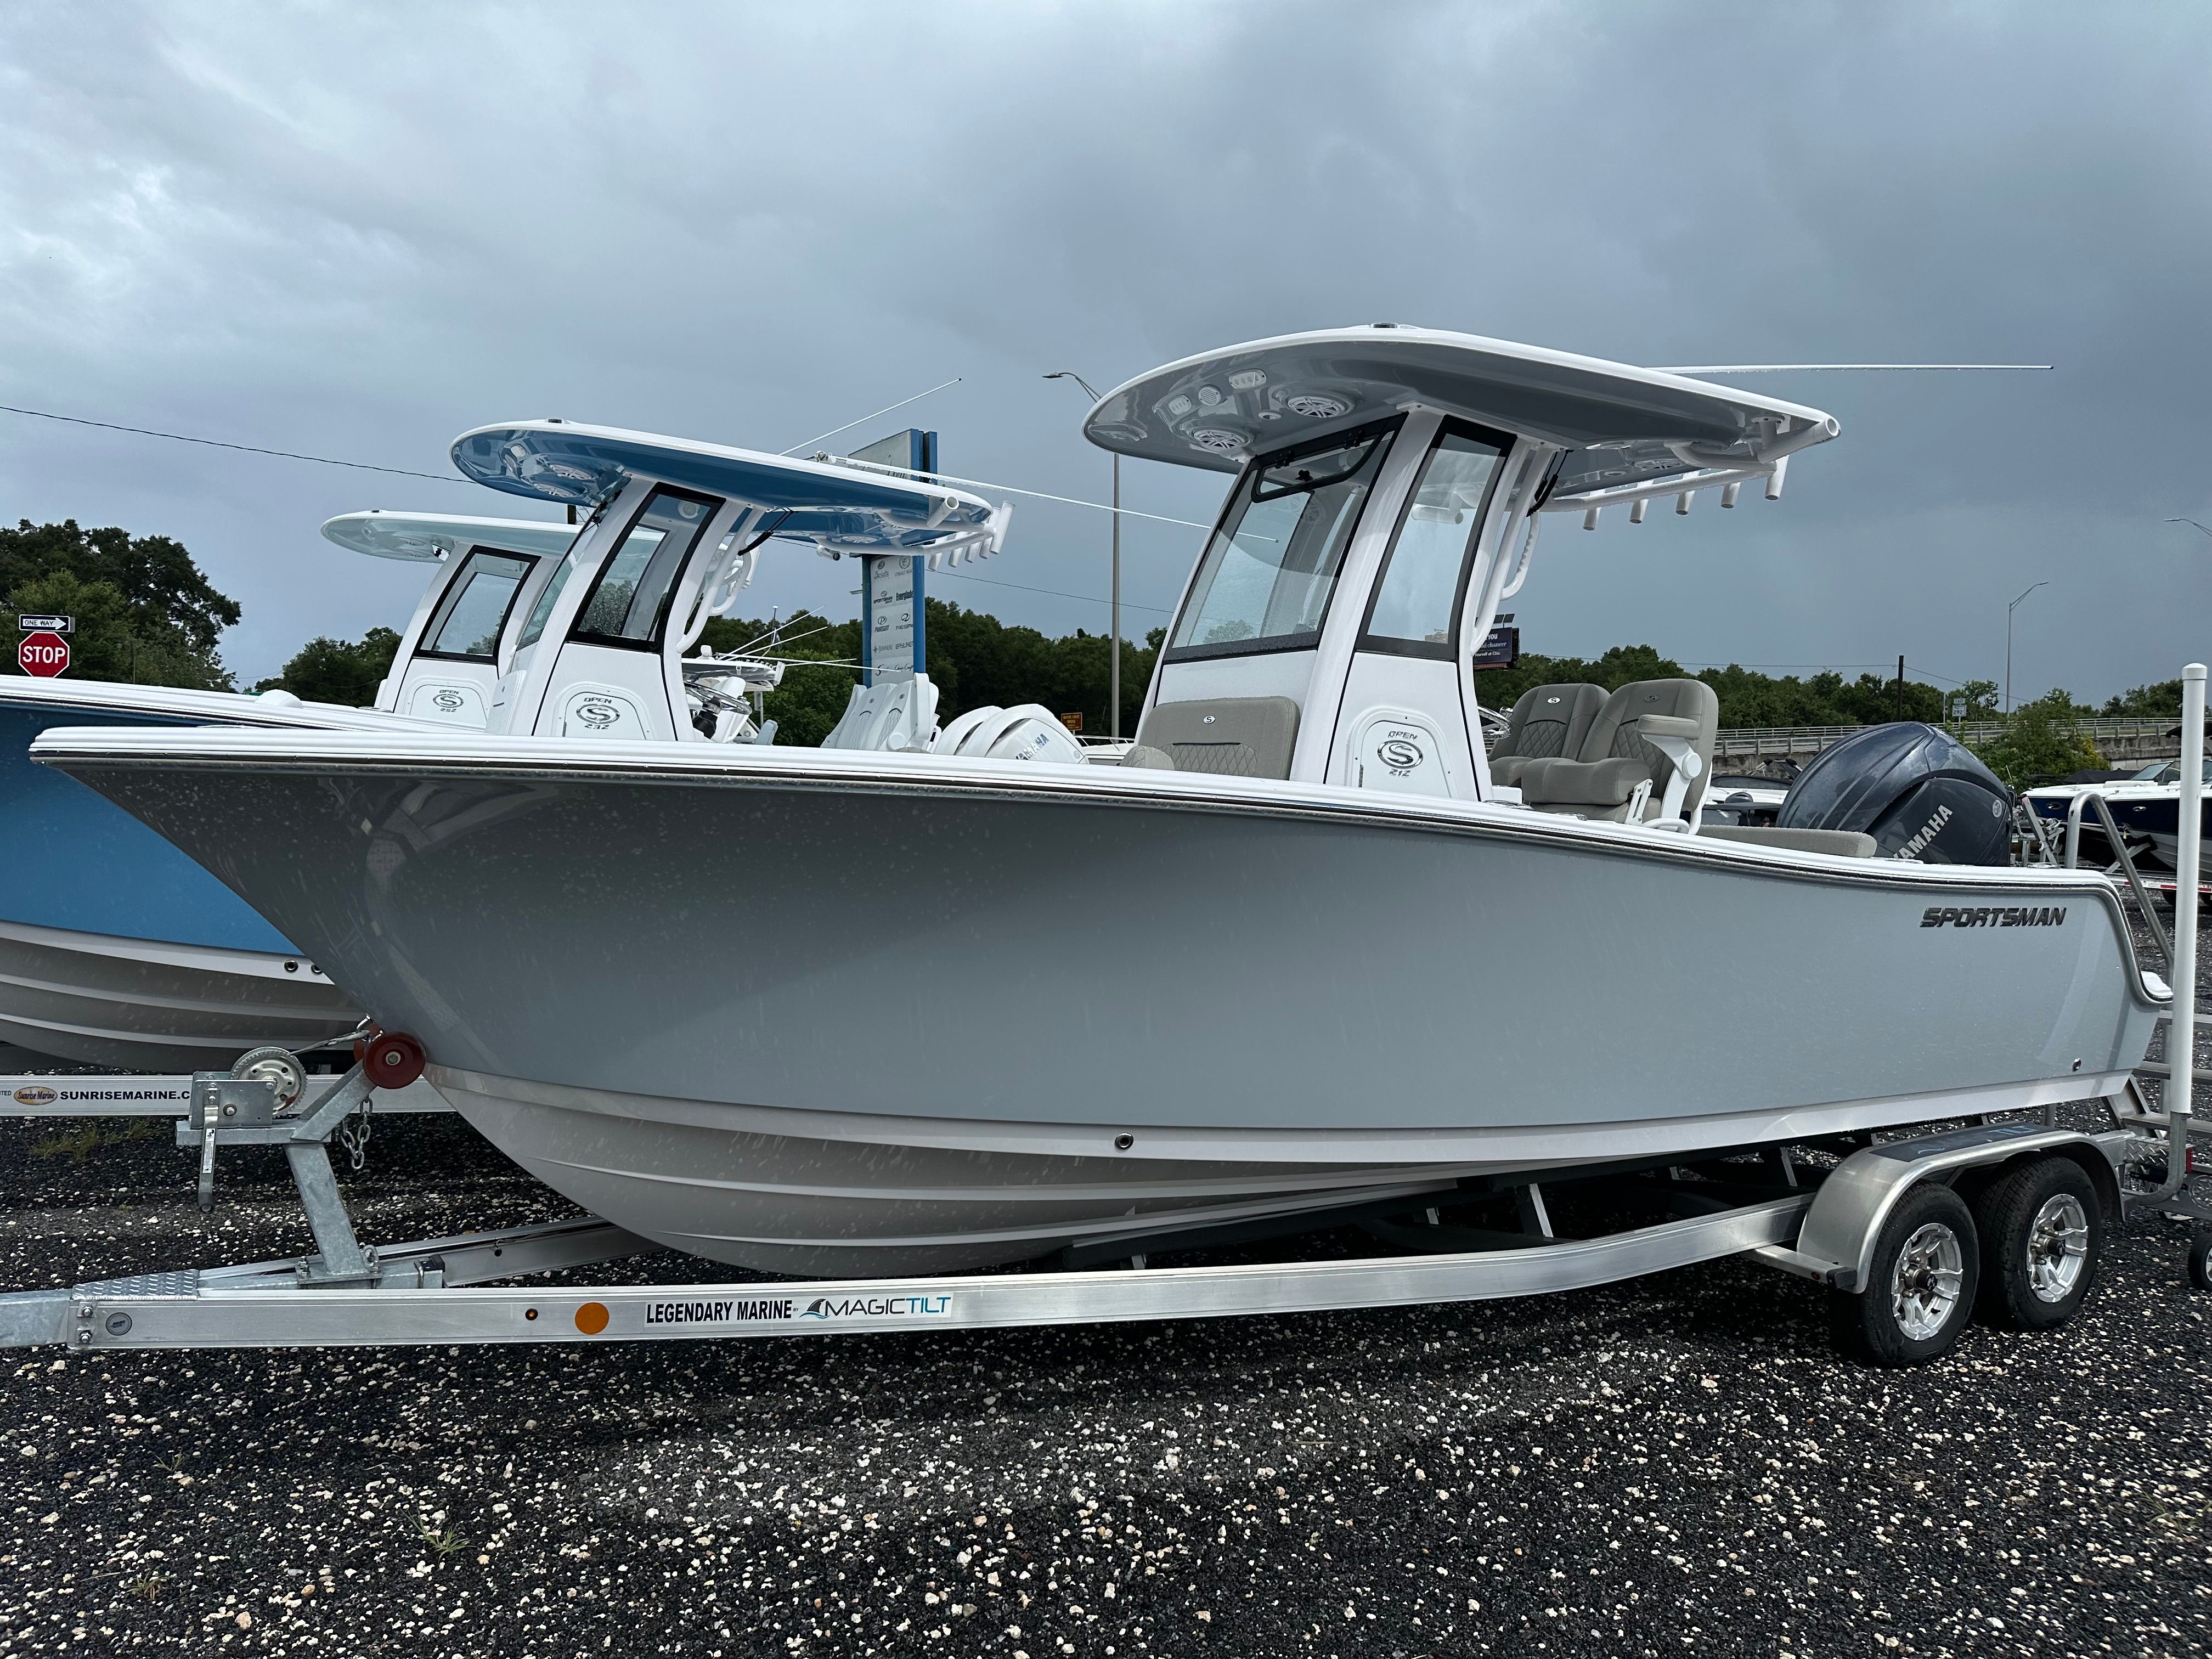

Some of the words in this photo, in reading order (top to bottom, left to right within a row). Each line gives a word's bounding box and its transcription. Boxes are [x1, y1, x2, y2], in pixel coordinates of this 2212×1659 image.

[22, 646, 66, 663] STOP
[1388, 731, 1418, 741] OPEN
[1389, 769, 1411, 777] 212
[1920, 907, 2067, 927] SPORTSMAN
[60, 1091, 190, 1099] SUNRISEMARINE.C
[647, 1302, 733, 1323] LEGENDARY
[737, 1300, 792, 1321] MARINE
[825, 1297, 951, 1316] MAGICTILT
